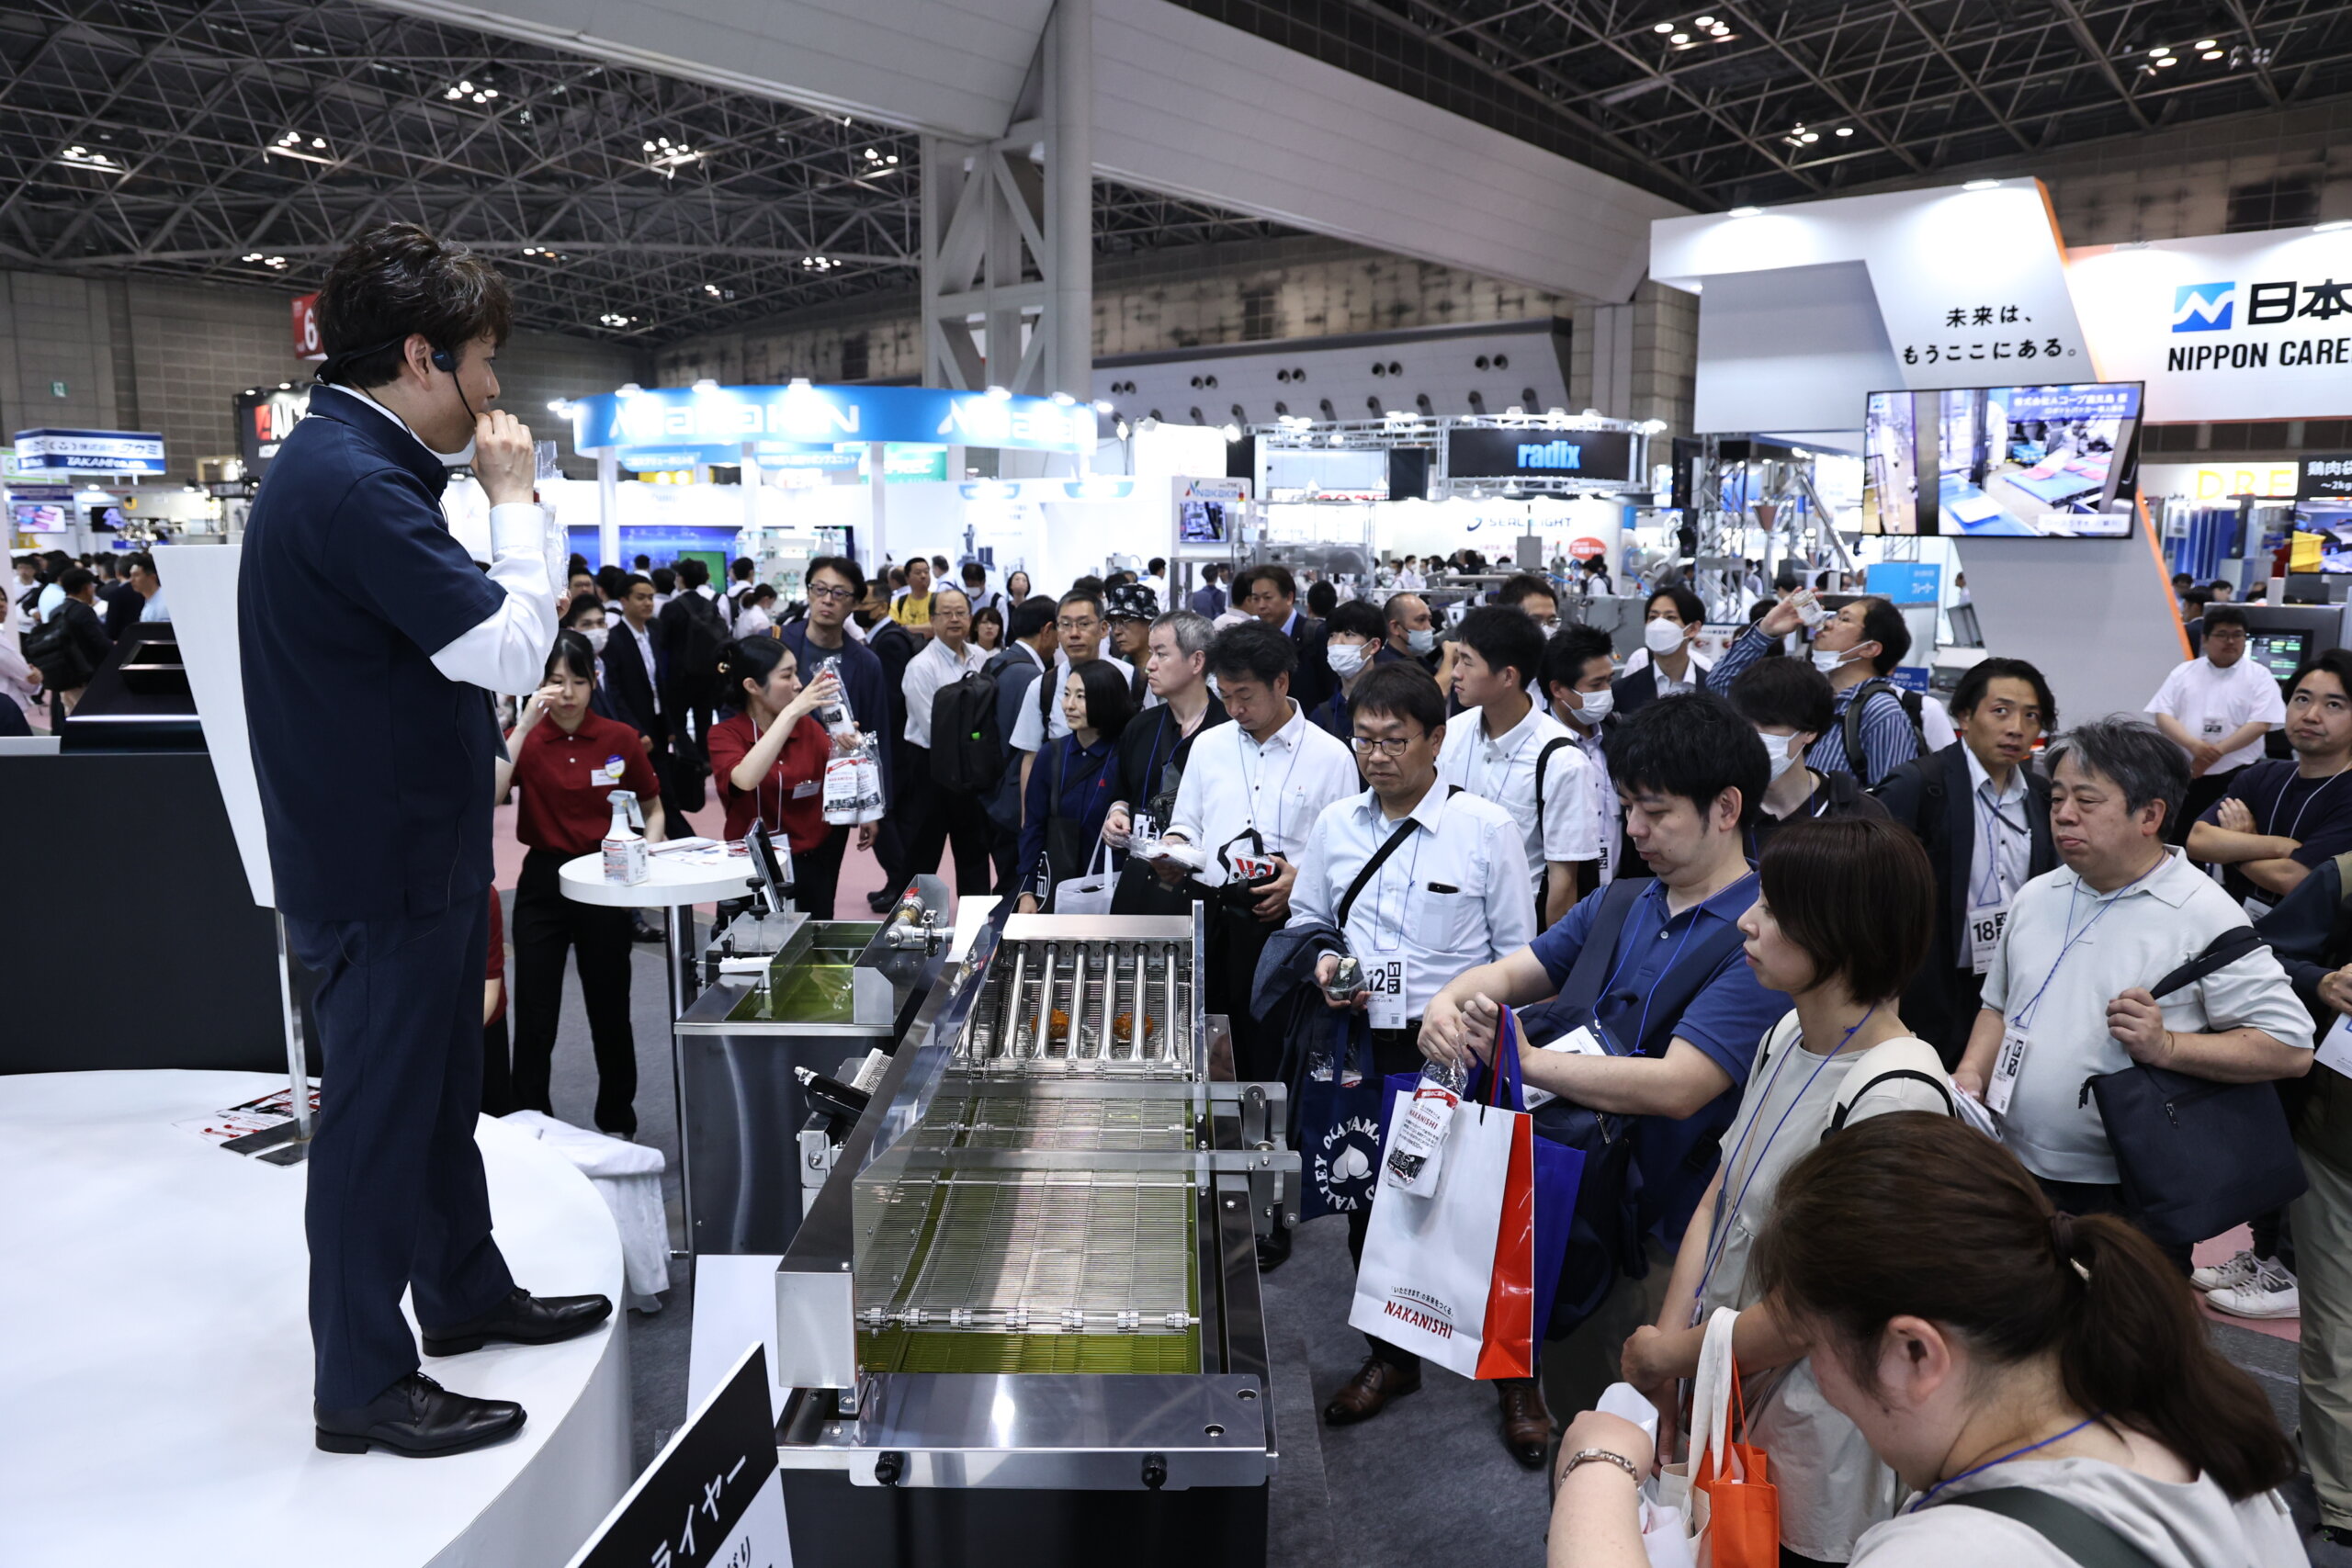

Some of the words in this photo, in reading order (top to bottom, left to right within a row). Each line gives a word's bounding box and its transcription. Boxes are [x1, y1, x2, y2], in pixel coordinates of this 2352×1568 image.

[2248, 278, 2352, 325] 日本
[1945, 305, 2033, 329] 未来は、
[1903, 337, 2077, 366] もうここにある。
[2167, 343, 2269, 372] NIPPON
[2278, 337, 2352, 367] CARE
[1518, 440, 1581, 469] radix
[1973, 920, 1995, 943] 18
[1384, 1300, 1453, 1340] NAKANISHI
